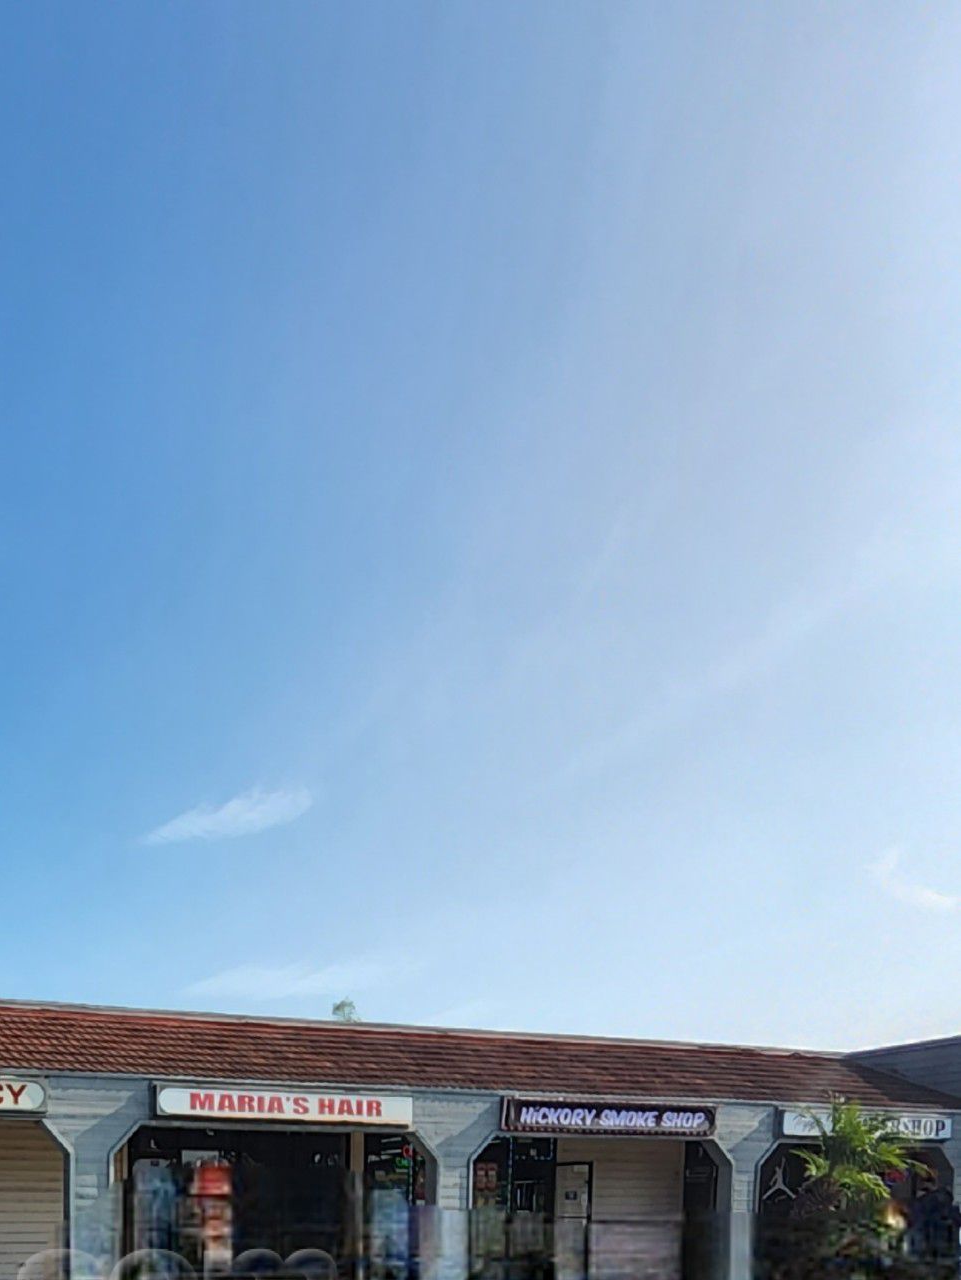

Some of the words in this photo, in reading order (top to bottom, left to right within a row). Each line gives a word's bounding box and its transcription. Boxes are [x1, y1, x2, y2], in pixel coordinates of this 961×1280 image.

[190, 1092, 309, 1115] MARIA'S
[318, 1097, 382, 1117] HAIR
[599, 1109, 659, 1127] SMOKE
[661, 1111, 706, 1128] SHOP
